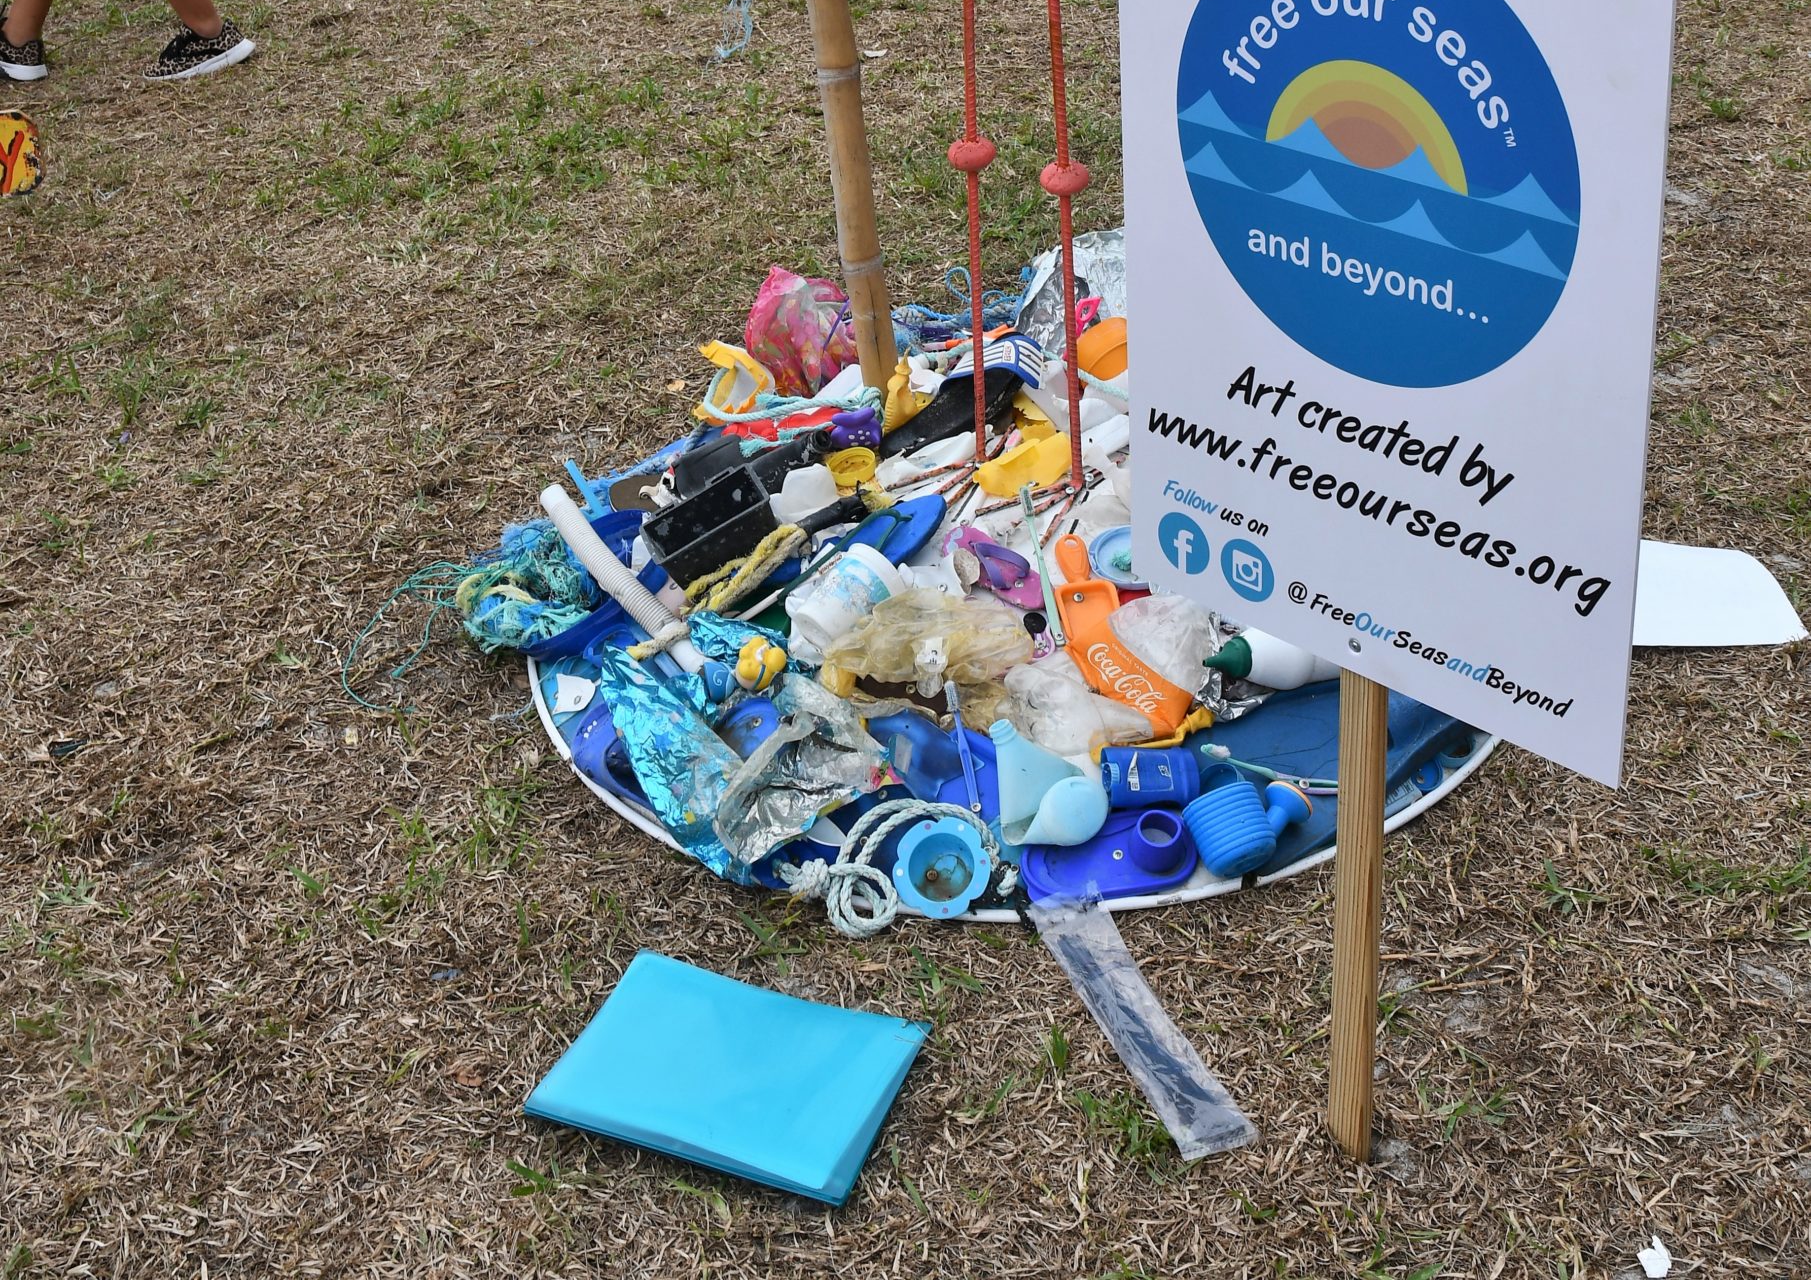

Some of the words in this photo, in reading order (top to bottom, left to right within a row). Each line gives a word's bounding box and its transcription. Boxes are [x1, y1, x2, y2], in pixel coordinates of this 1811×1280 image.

[1247, 228, 1310, 268] and
[1321, 243, 1489, 324] beyond...
[1226, 366, 1296, 417] Art
[1299, 399, 1460, 477] created
[1460, 443, 1515, 506] by
[1148, 407, 1611, 617] www.freeourseas.org
[1163, 479, 1218, 516] Follow
[1220, 507, 1244, 527] us
[1247, 518, 1270, 537] on
